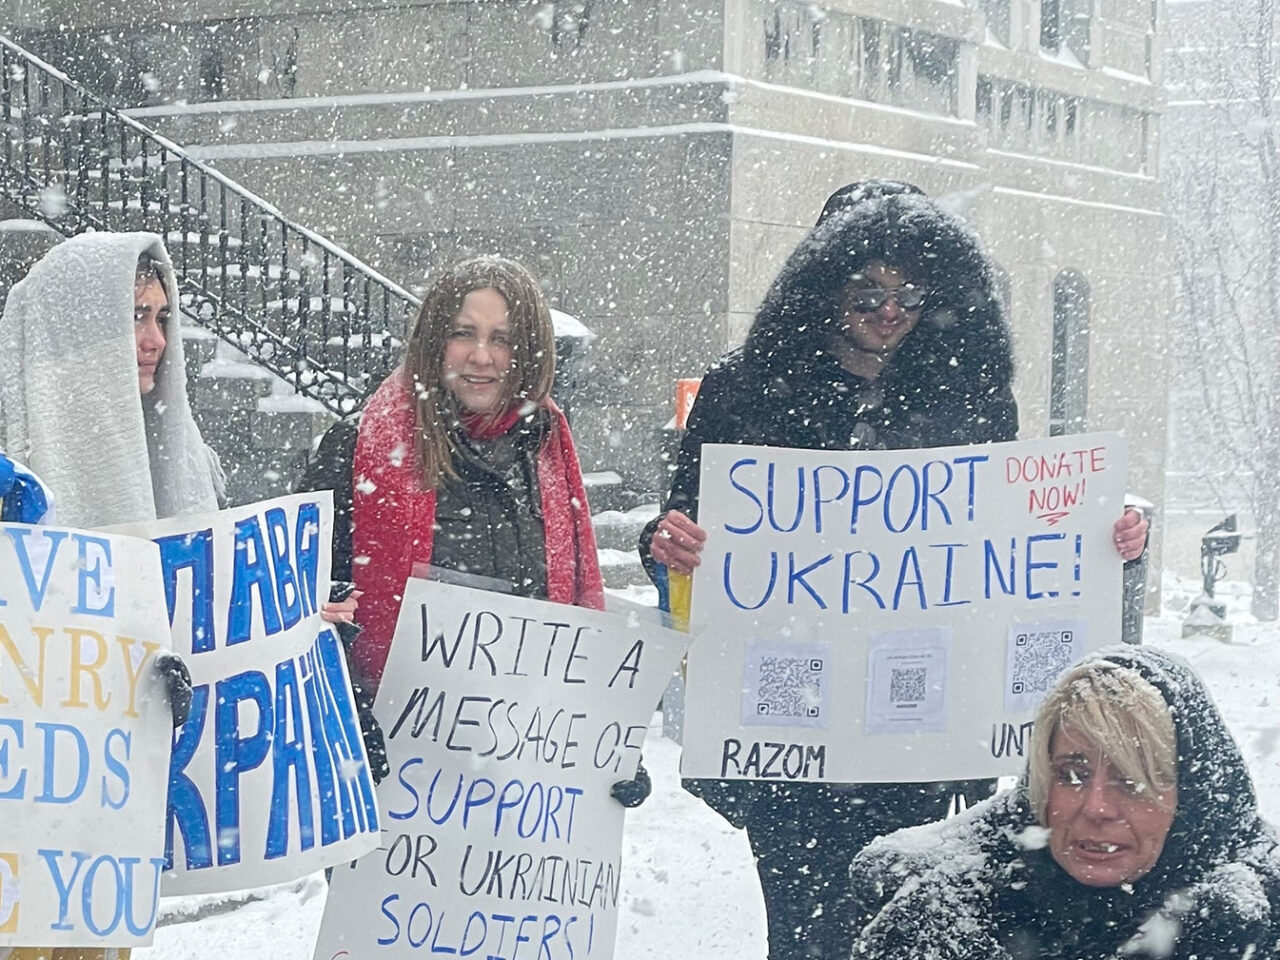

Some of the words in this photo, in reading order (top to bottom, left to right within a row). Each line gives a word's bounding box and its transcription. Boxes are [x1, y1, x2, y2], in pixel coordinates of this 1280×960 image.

[724, 455, 989, 535] SUPPORT
[1006, 447, 1107, 484] DONATE
[1028, 478, 1087, 513] NOW!
[722, 532, 1083, 614] UKRAINE!
[420, 603, 602, 685] WRITE
[607, 639, 645, 689] A
[163, 629, 380, 872] КРАЇНІ
[388, 686, 587, 769] MESSAGE
[594, 721, 648, 773] OF
[721, 738, 826, 779] RAZOM
[388, 757, 584, 844] SUPPORT
[38, 849, 167, 937] YOU
[459, 845, 621, 910] UKRAINIAN
